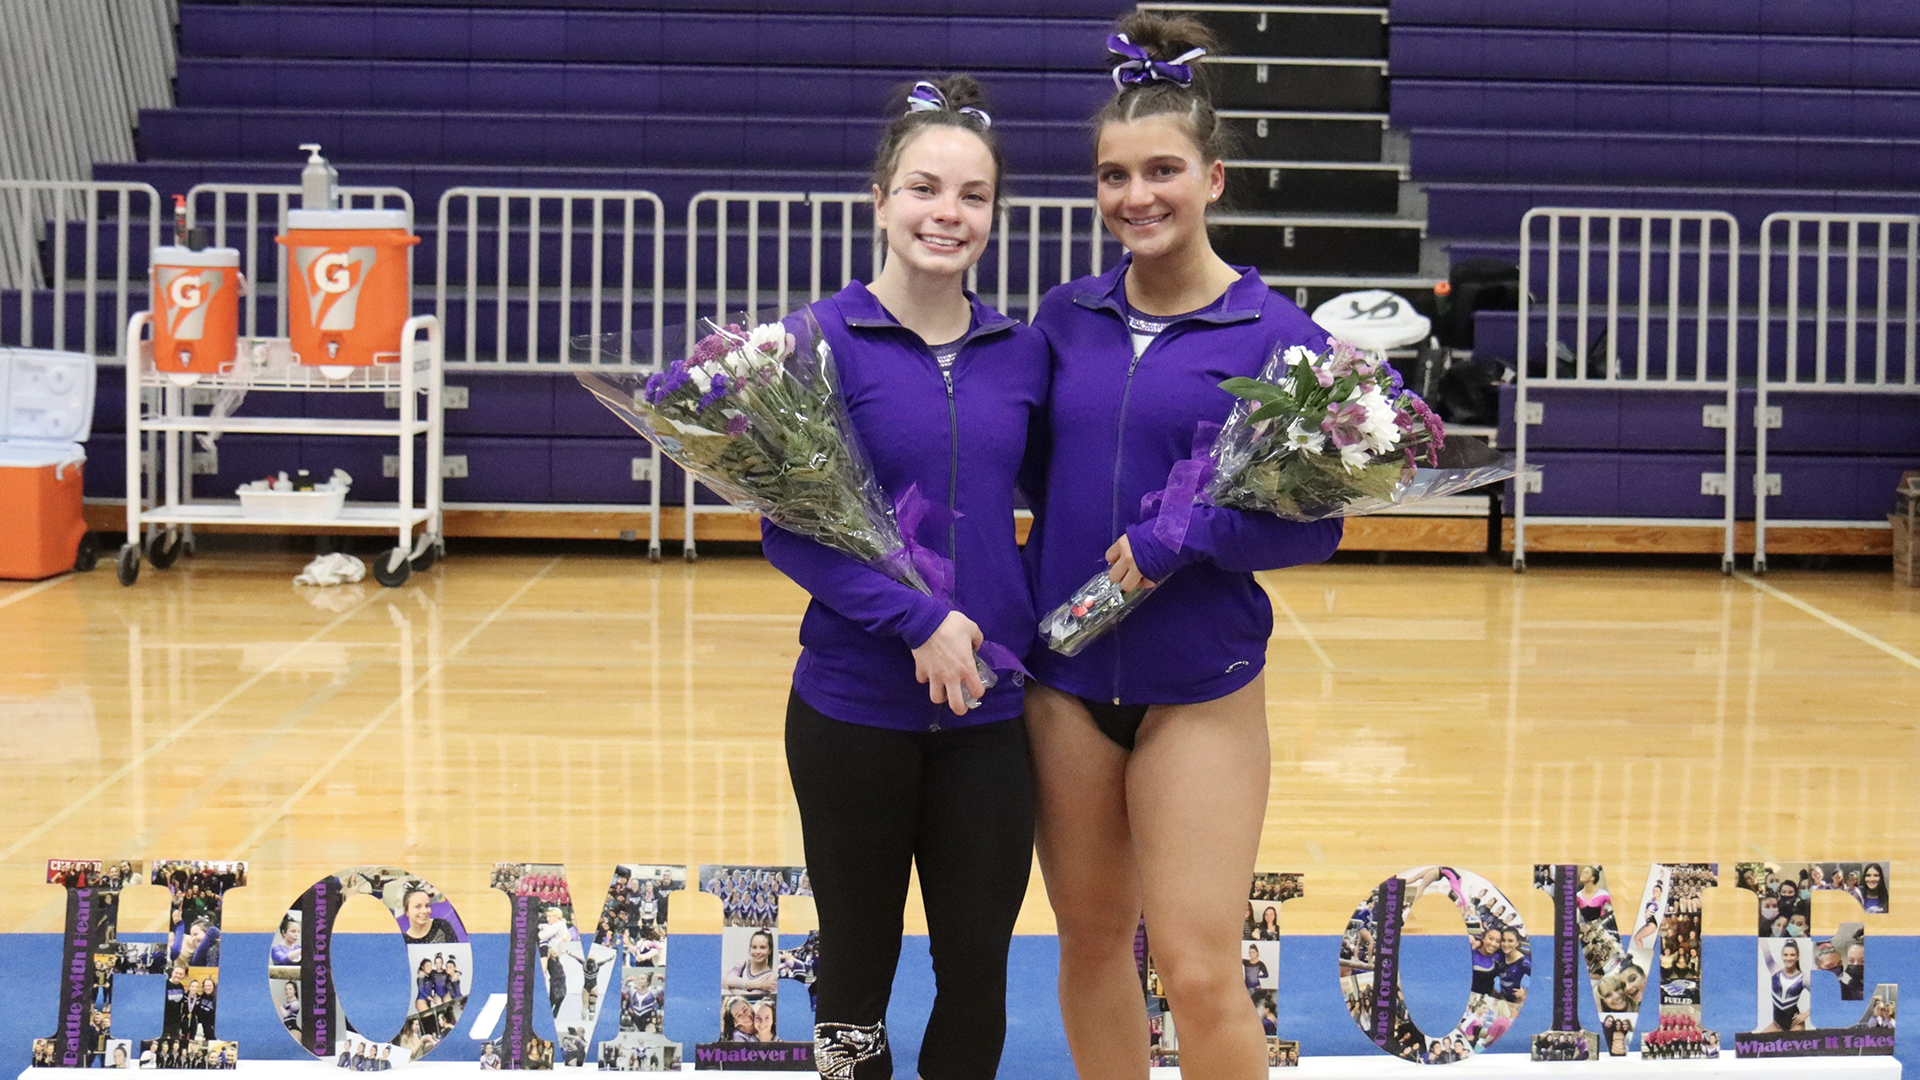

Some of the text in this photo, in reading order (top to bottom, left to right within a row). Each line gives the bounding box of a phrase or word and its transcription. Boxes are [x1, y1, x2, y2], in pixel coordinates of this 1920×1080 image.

[1257, 12, 1267, 31] J
[1257, 119, 1268, 137] G
[1269, 169, 1280, 188] F
[1284, 226, 1295, 247] E
[314, 253, 350, 293] G
[170, 275, 201, 308] G
[1296, 287, 1307, 308] D
[514, 896, 529, 971] Intention
[1562, 865, 1576, 1031] Fueled with Intention
[314, 883, 327, 1055] One Force Forward
[1374, 878, 1399, 1046] One Force Forward
[63, 888, 92, 1065] Battle with Heart
[513, 974, 525, 1011] with
[1664, 996, 1693, 1004] FUELED
[697, 1048, 808, 1062] Whatever It
[1735, 1034, 1895, 1055] Whatever It Takes
